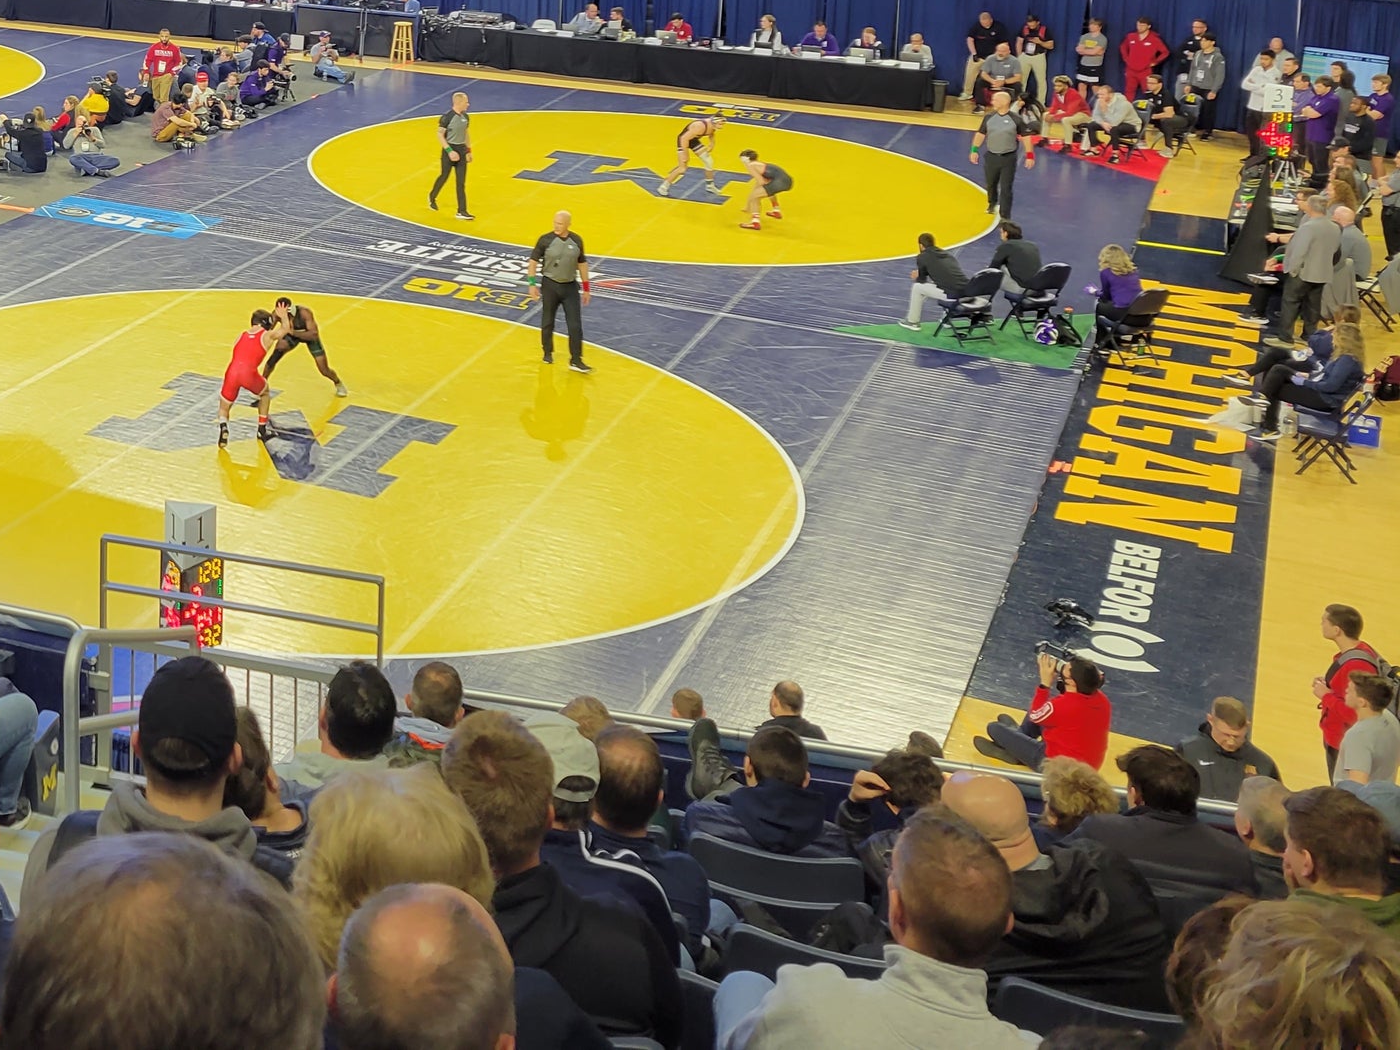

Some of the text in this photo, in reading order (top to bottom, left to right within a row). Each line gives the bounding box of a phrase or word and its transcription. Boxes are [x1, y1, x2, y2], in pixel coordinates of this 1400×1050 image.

[1273, 88, 1283, 103] 3
[1054, 278, 1262, 554] MICHIGAN
[1098, 539, 1162, 623] BELFOR
